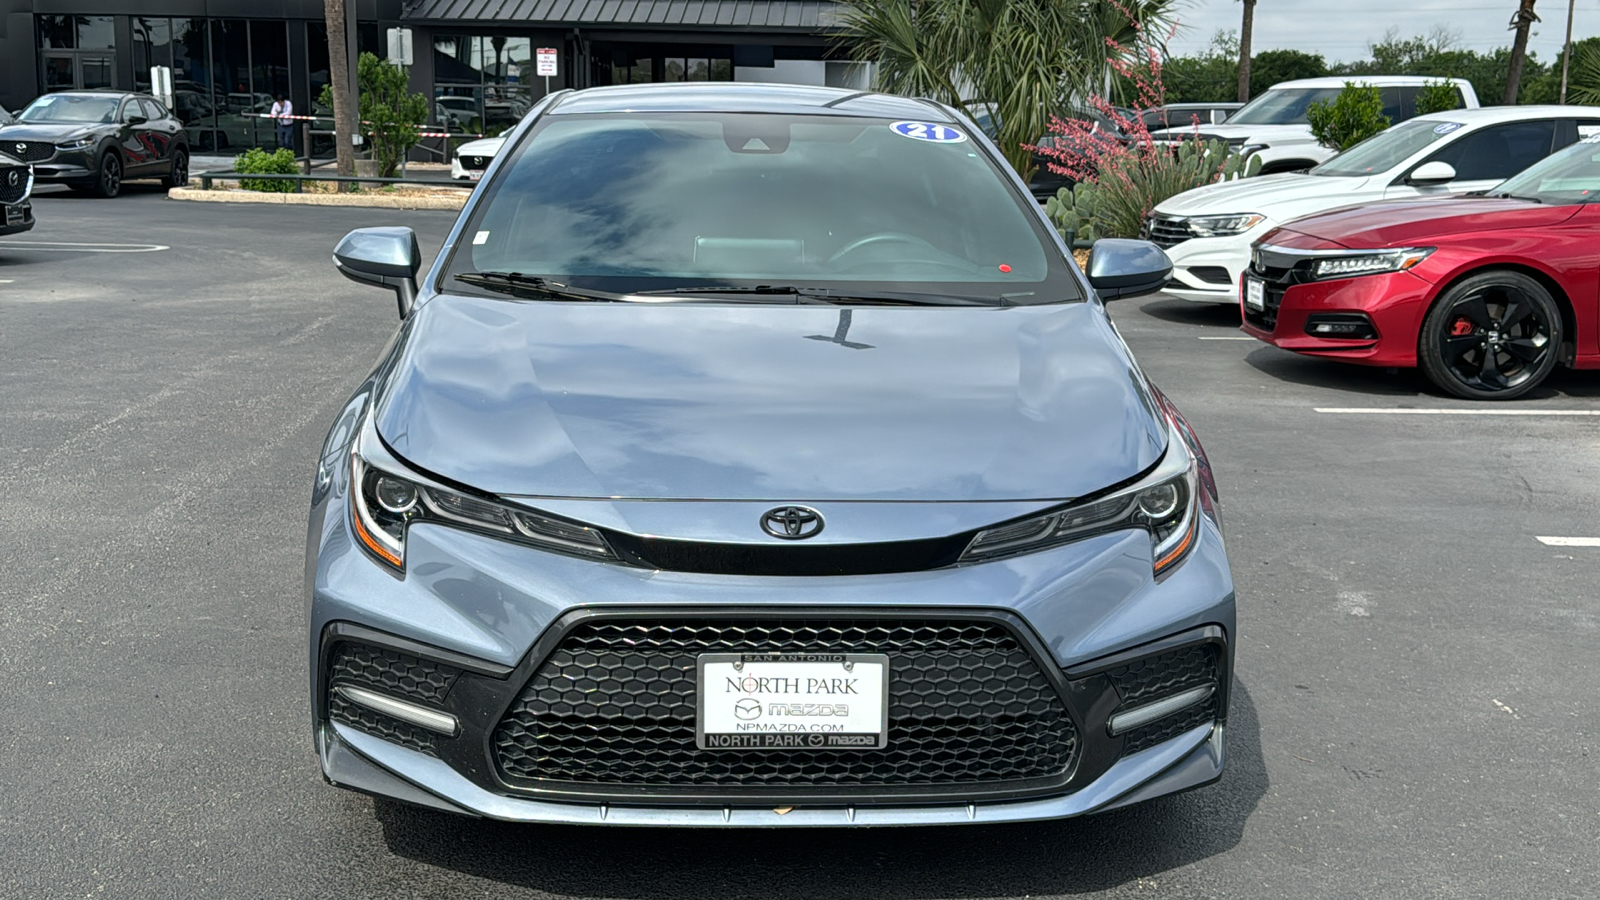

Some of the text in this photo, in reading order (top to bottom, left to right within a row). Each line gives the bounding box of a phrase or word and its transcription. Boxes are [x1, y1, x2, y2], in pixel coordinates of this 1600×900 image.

[906, 123, 945, 139] 21
[725, 676, 859, 695] NORTH PARK
[768, 703, 849, 717] mazda
[736, 723, 844, 732] NPMAZDA.COM
[708, 735, 875, 746] NORTH PARK mazda
